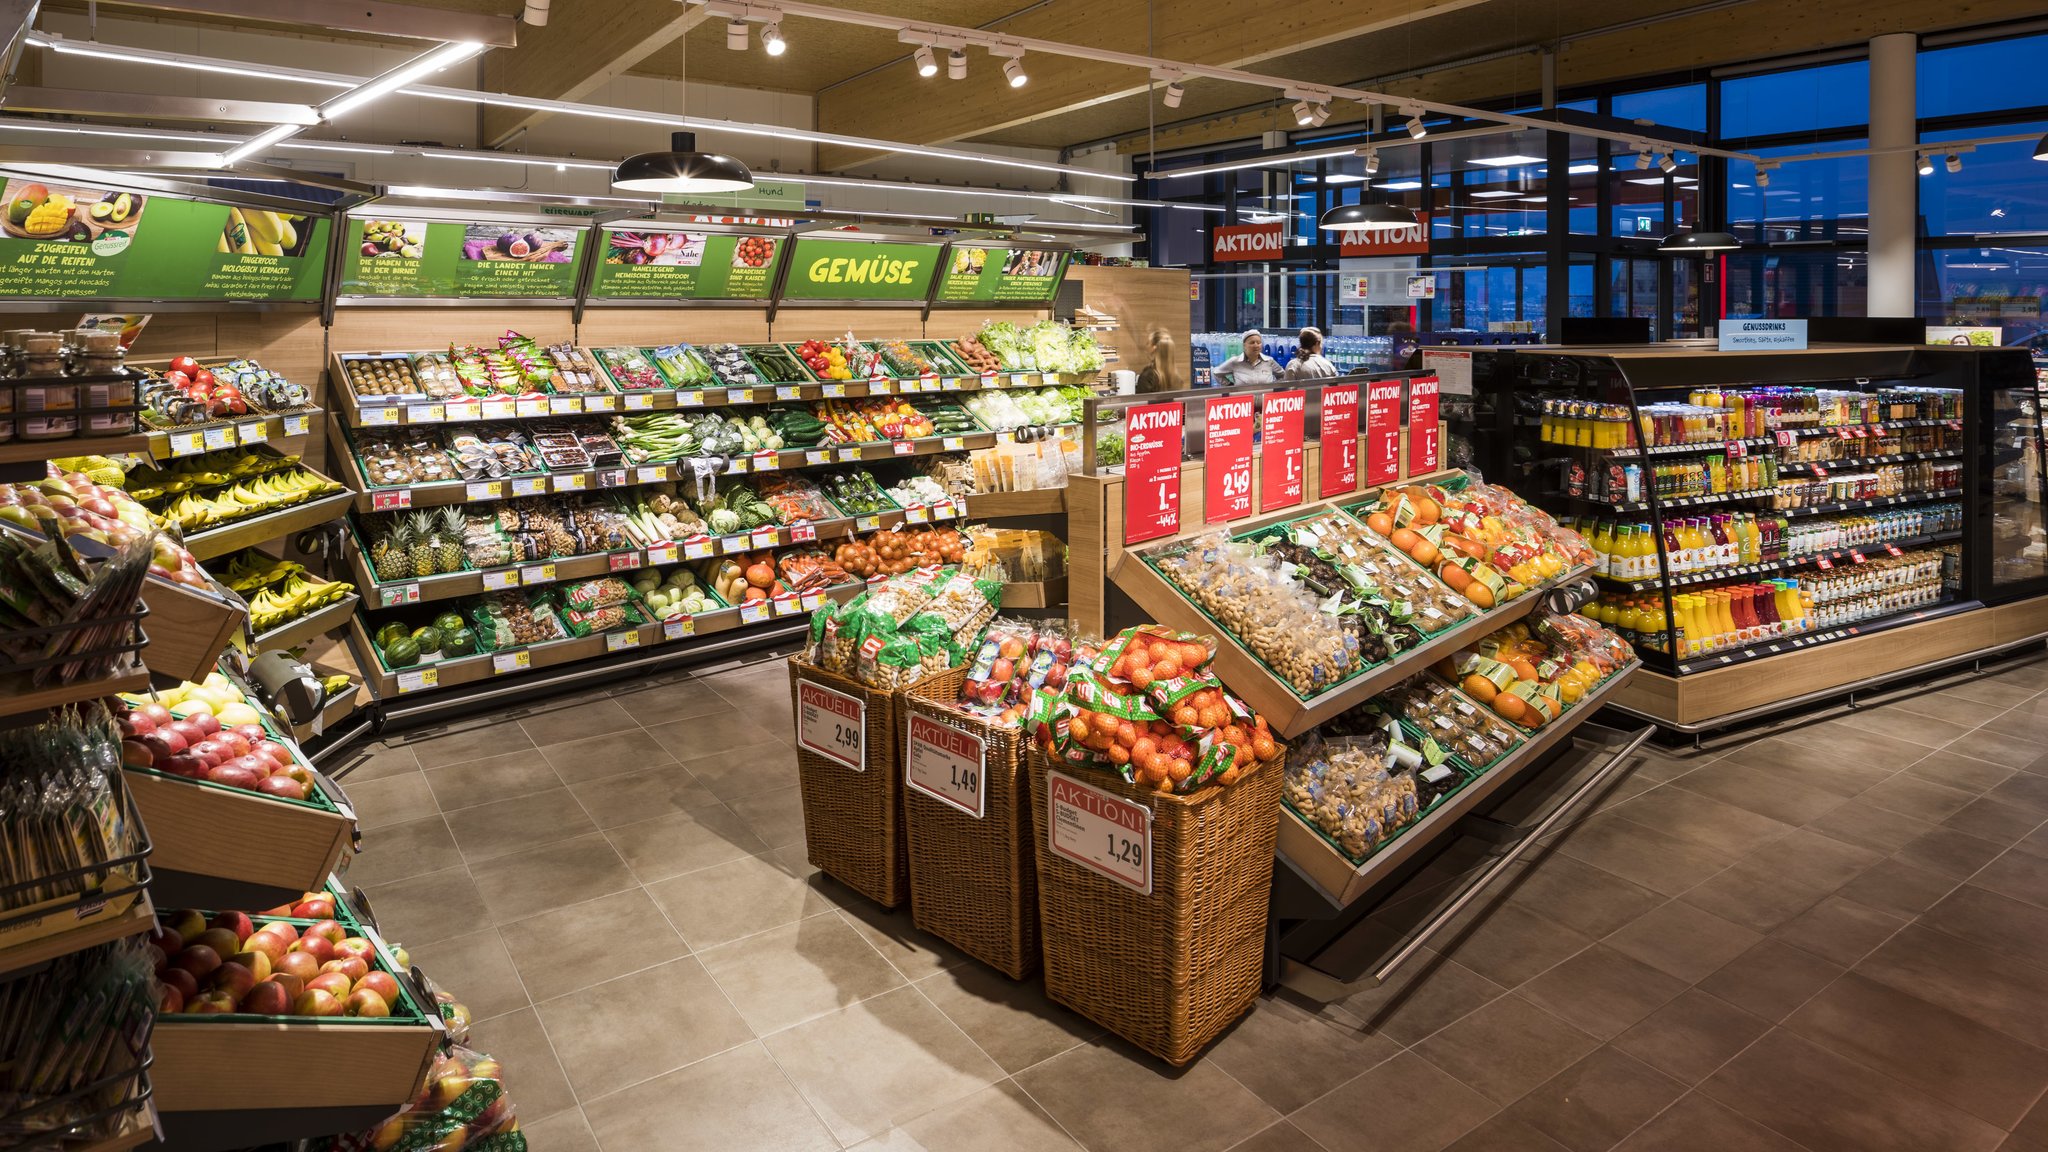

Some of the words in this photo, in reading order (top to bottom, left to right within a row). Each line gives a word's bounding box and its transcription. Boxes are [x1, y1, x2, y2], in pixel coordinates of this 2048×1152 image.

[759, 187, 784, 196] Hund
[1342, 223, 1428, 246] AKTION!
[34, 243, 88, 255] ZUGREIFEN
[1216, 232, 1283, 252] AKTION!
[17, 254, 39, 264] AUF
[42, 256, 58, 265] DIE
[61, 256, 96, 267] REIFEN!
[8, 265, 32, 275] länger
[35, 267, 60, 275] warten
[63, 267, 75, 275] mit
[222, 264, 258, 273] BIOLOGISCH
[808, 254, 919, 284] GEMÜSE
[22, 287, 32, 295] Sie
[34, 287, 60, 296] sofort
[62, 288, 98, 298] geniessen!
[1742, 323, 1786, 331] GENUSSDRINKS
[1370, 386, 1400, 401] AKTION!
[1412, 382, 1438, 396] AKTION!
[1324, 390, 1357, 406] AKTION!
[1208, 402, 1251, 421] AKTION!
[1265, 396, 1303, 415] AKTION!
[1129, 410, 1180, 431] AKTION!
[1285, 485, 1300, 496] -44%
[1231, 497, 1249, 510] -37%
[1156, 513, 1176, 527] -44%
[425, 672, 436, 680] 2,99
[802, 688, 859, 721] AKTUELL!
[835, 724, 859, 749] 2,99
[912, 722, 978, 761] AKTUELL!
[950, 765, 977, 794] 1,49
[1054, 783, 1143, 832] AKTION!
[1056, 803, 1077, 816] S-Budget
[1056, 809, 1079, 823] S-BUDGET
[1108, 834, 1142, 867] 1,29
